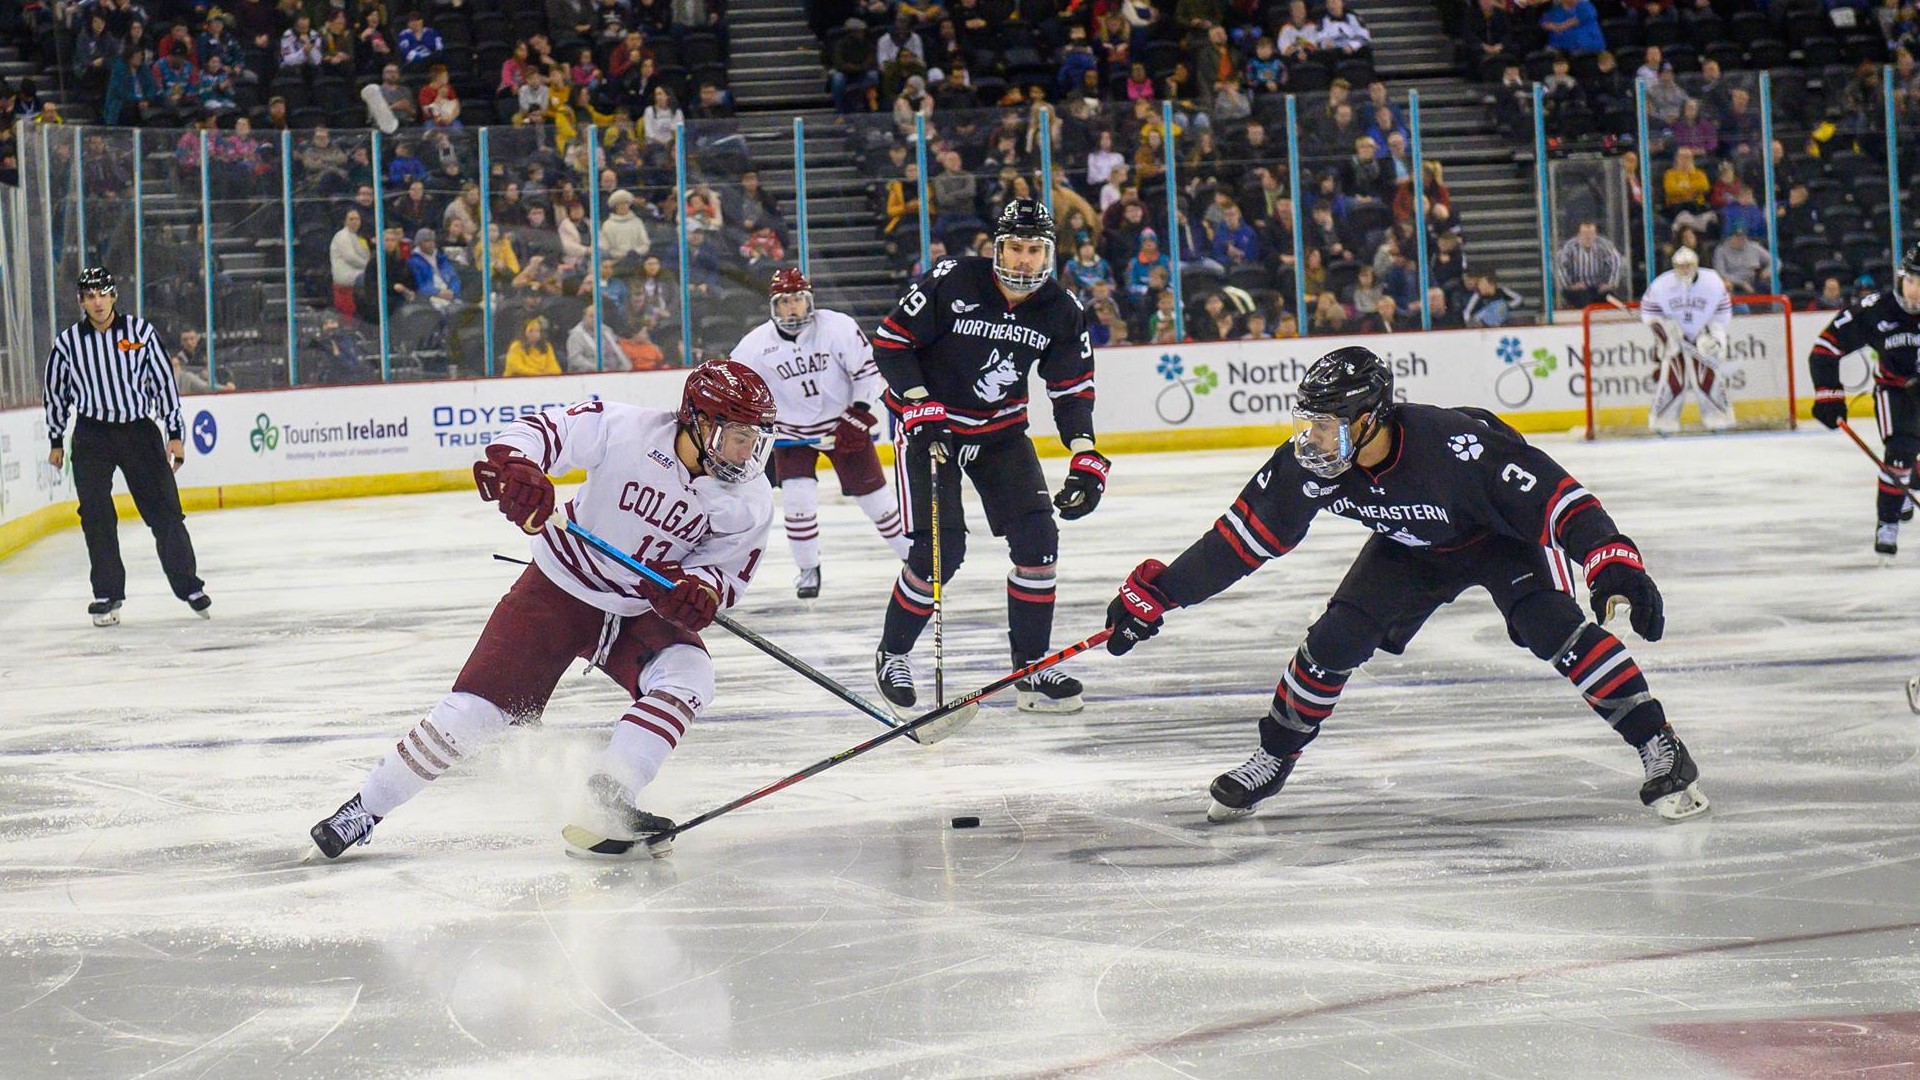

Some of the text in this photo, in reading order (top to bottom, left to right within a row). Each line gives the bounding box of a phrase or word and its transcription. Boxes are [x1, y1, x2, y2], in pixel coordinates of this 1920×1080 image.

[776, 352, 830, 380] OLGATE
[1227, 358, 1306, 385] North
[800, 379, 820, 398] 11
[282, 416, 409, 445] Tourism Ireland
[652, 449, 675, 467] ECAC
[1078, 458, 1109, 475] BAU
[1501, 463, 1537, 492] 3
[619, 481, 712, 544] COLGA
[630, 534, 673, 564] 13
[1121, 582, 1153, 614] UER
